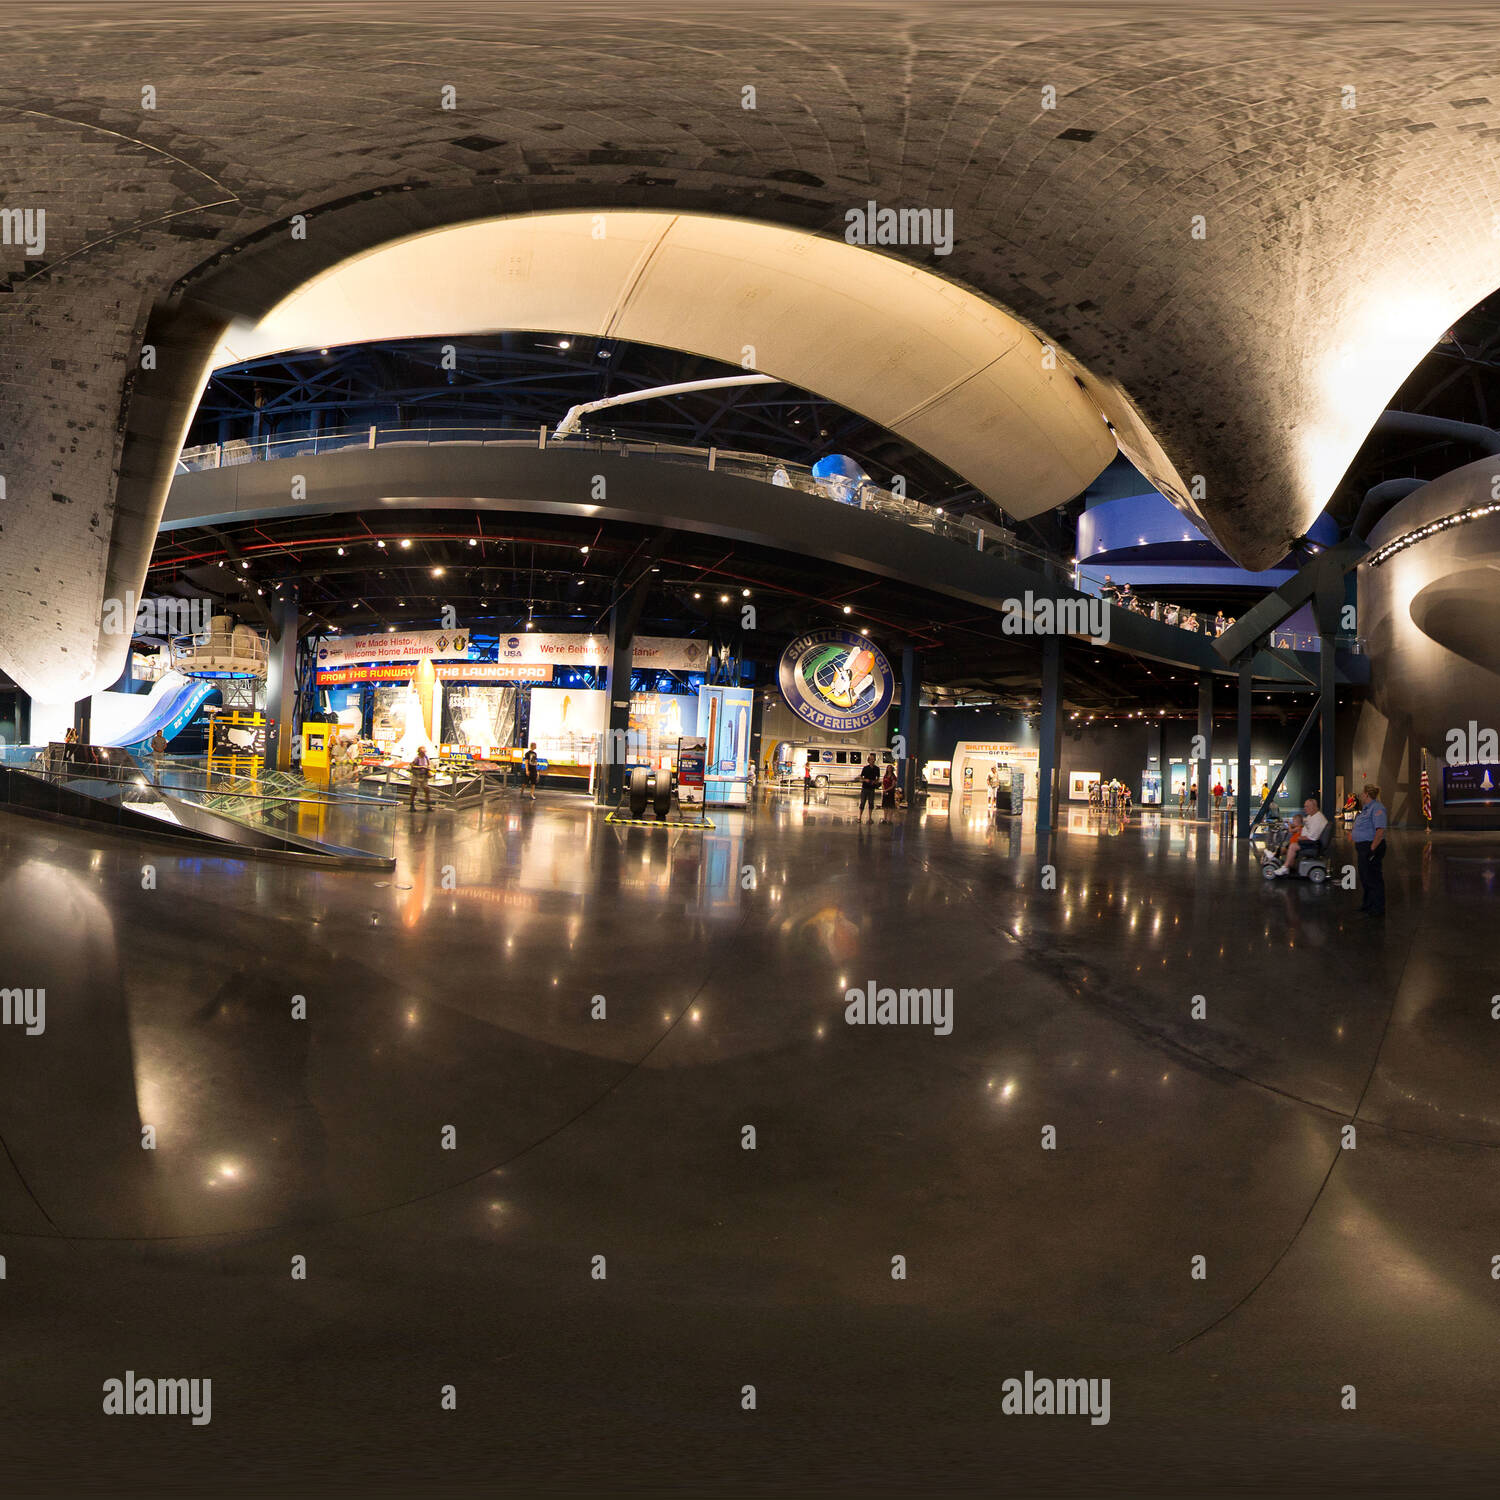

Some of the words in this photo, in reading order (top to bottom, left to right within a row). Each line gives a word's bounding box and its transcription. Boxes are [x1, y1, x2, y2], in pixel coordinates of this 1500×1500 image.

[355, 640, 366, 648] We
[368, 639, 388, 648] Made
[540, 644, 564, 653] We're
[344, 649, 377, 660] Welcome
[378, 647, 400, 657] Home
[403, 646, 434, 655] Atlantis
[788, 631, 843, 660] SHUTTLE
[849, 635, 890, 675] LAUNCH
[320, 673, 346, 682] FROM
[370, 668, 416, 678] RUNWAY
[462, 668, 514, 677] LAUNCH
[517, 668, 546, 677] PAD
[798, 701, 877, 729] EXPERIENCE
